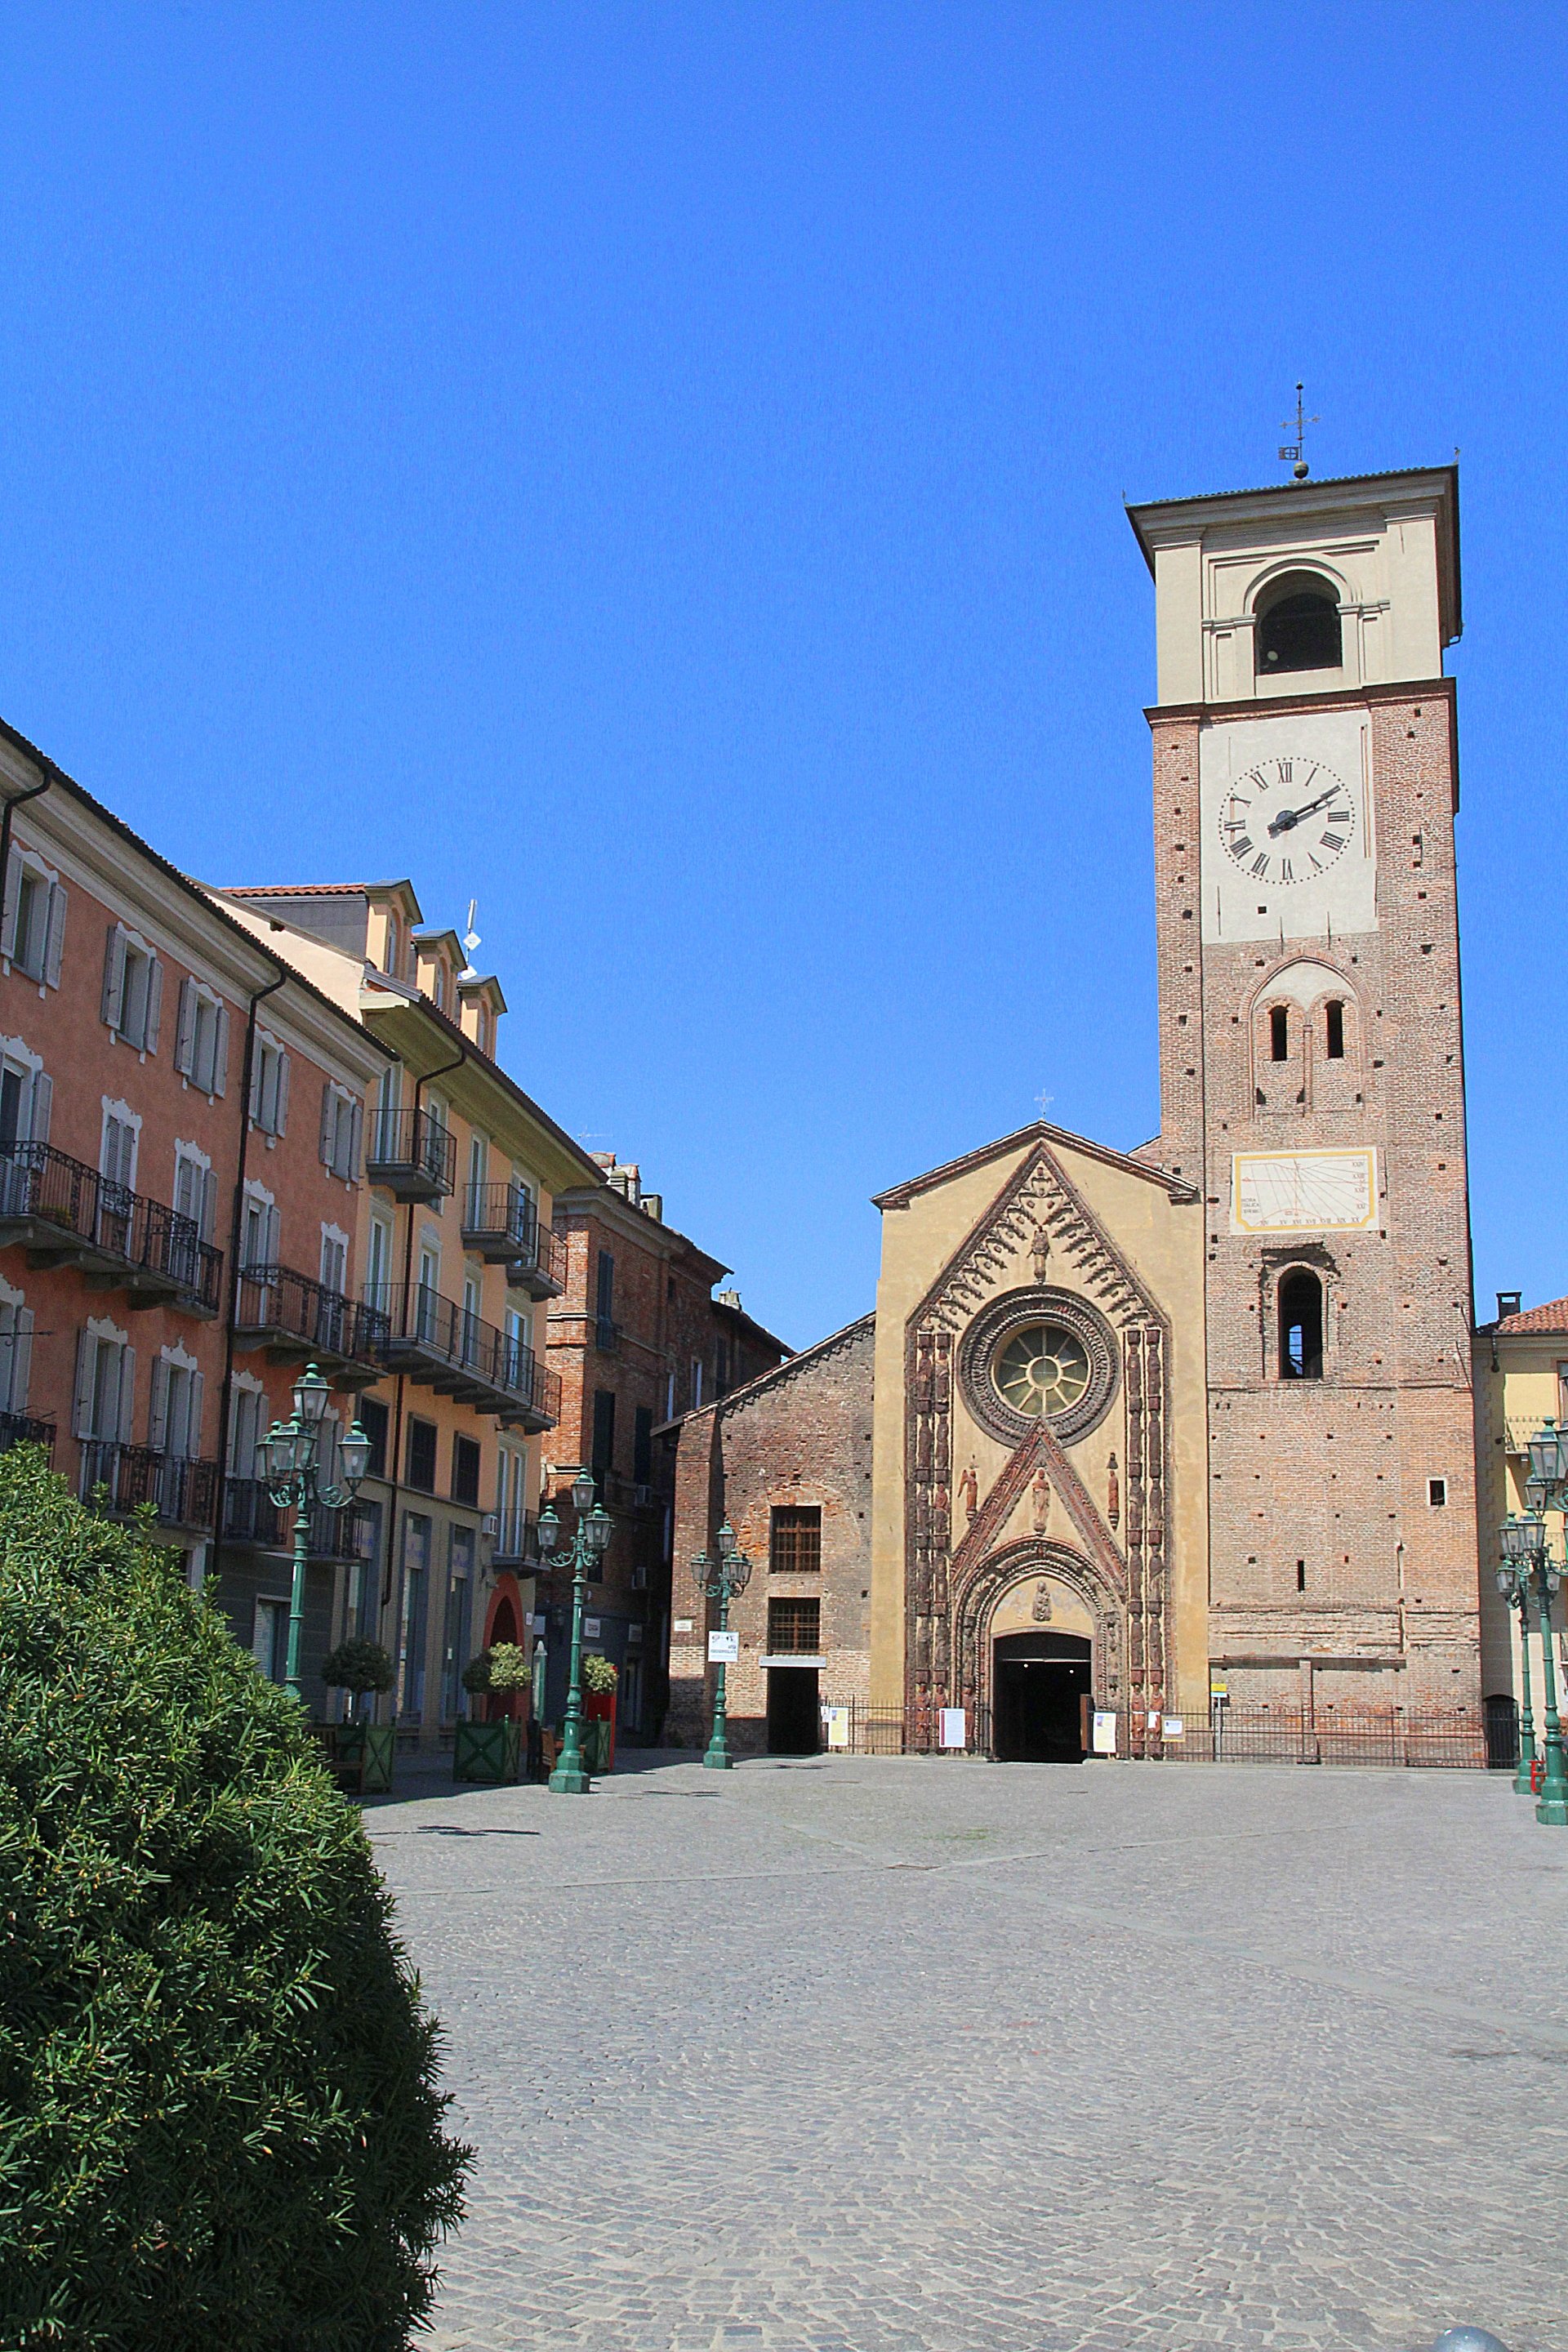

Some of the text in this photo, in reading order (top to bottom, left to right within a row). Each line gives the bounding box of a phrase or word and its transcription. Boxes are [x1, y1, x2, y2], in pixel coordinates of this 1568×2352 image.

[1250, 770, 1269, 792] XI
[1277, 762, 1293, 784] XII
[1305, 768, 1317, 786] I
[1230, 793, 1252, 808] X
[1224, 819, 1245, 831] IX
[1327, 810, 1350, 822] III
[1228, 835, 1254, 860] VIII
[1320, 831, 1345, 852] IIII
[1250, 852, 1271, 876] VII
[1282, 858, 1294, 880] VI
[1307, 850, 1322, 871] V
